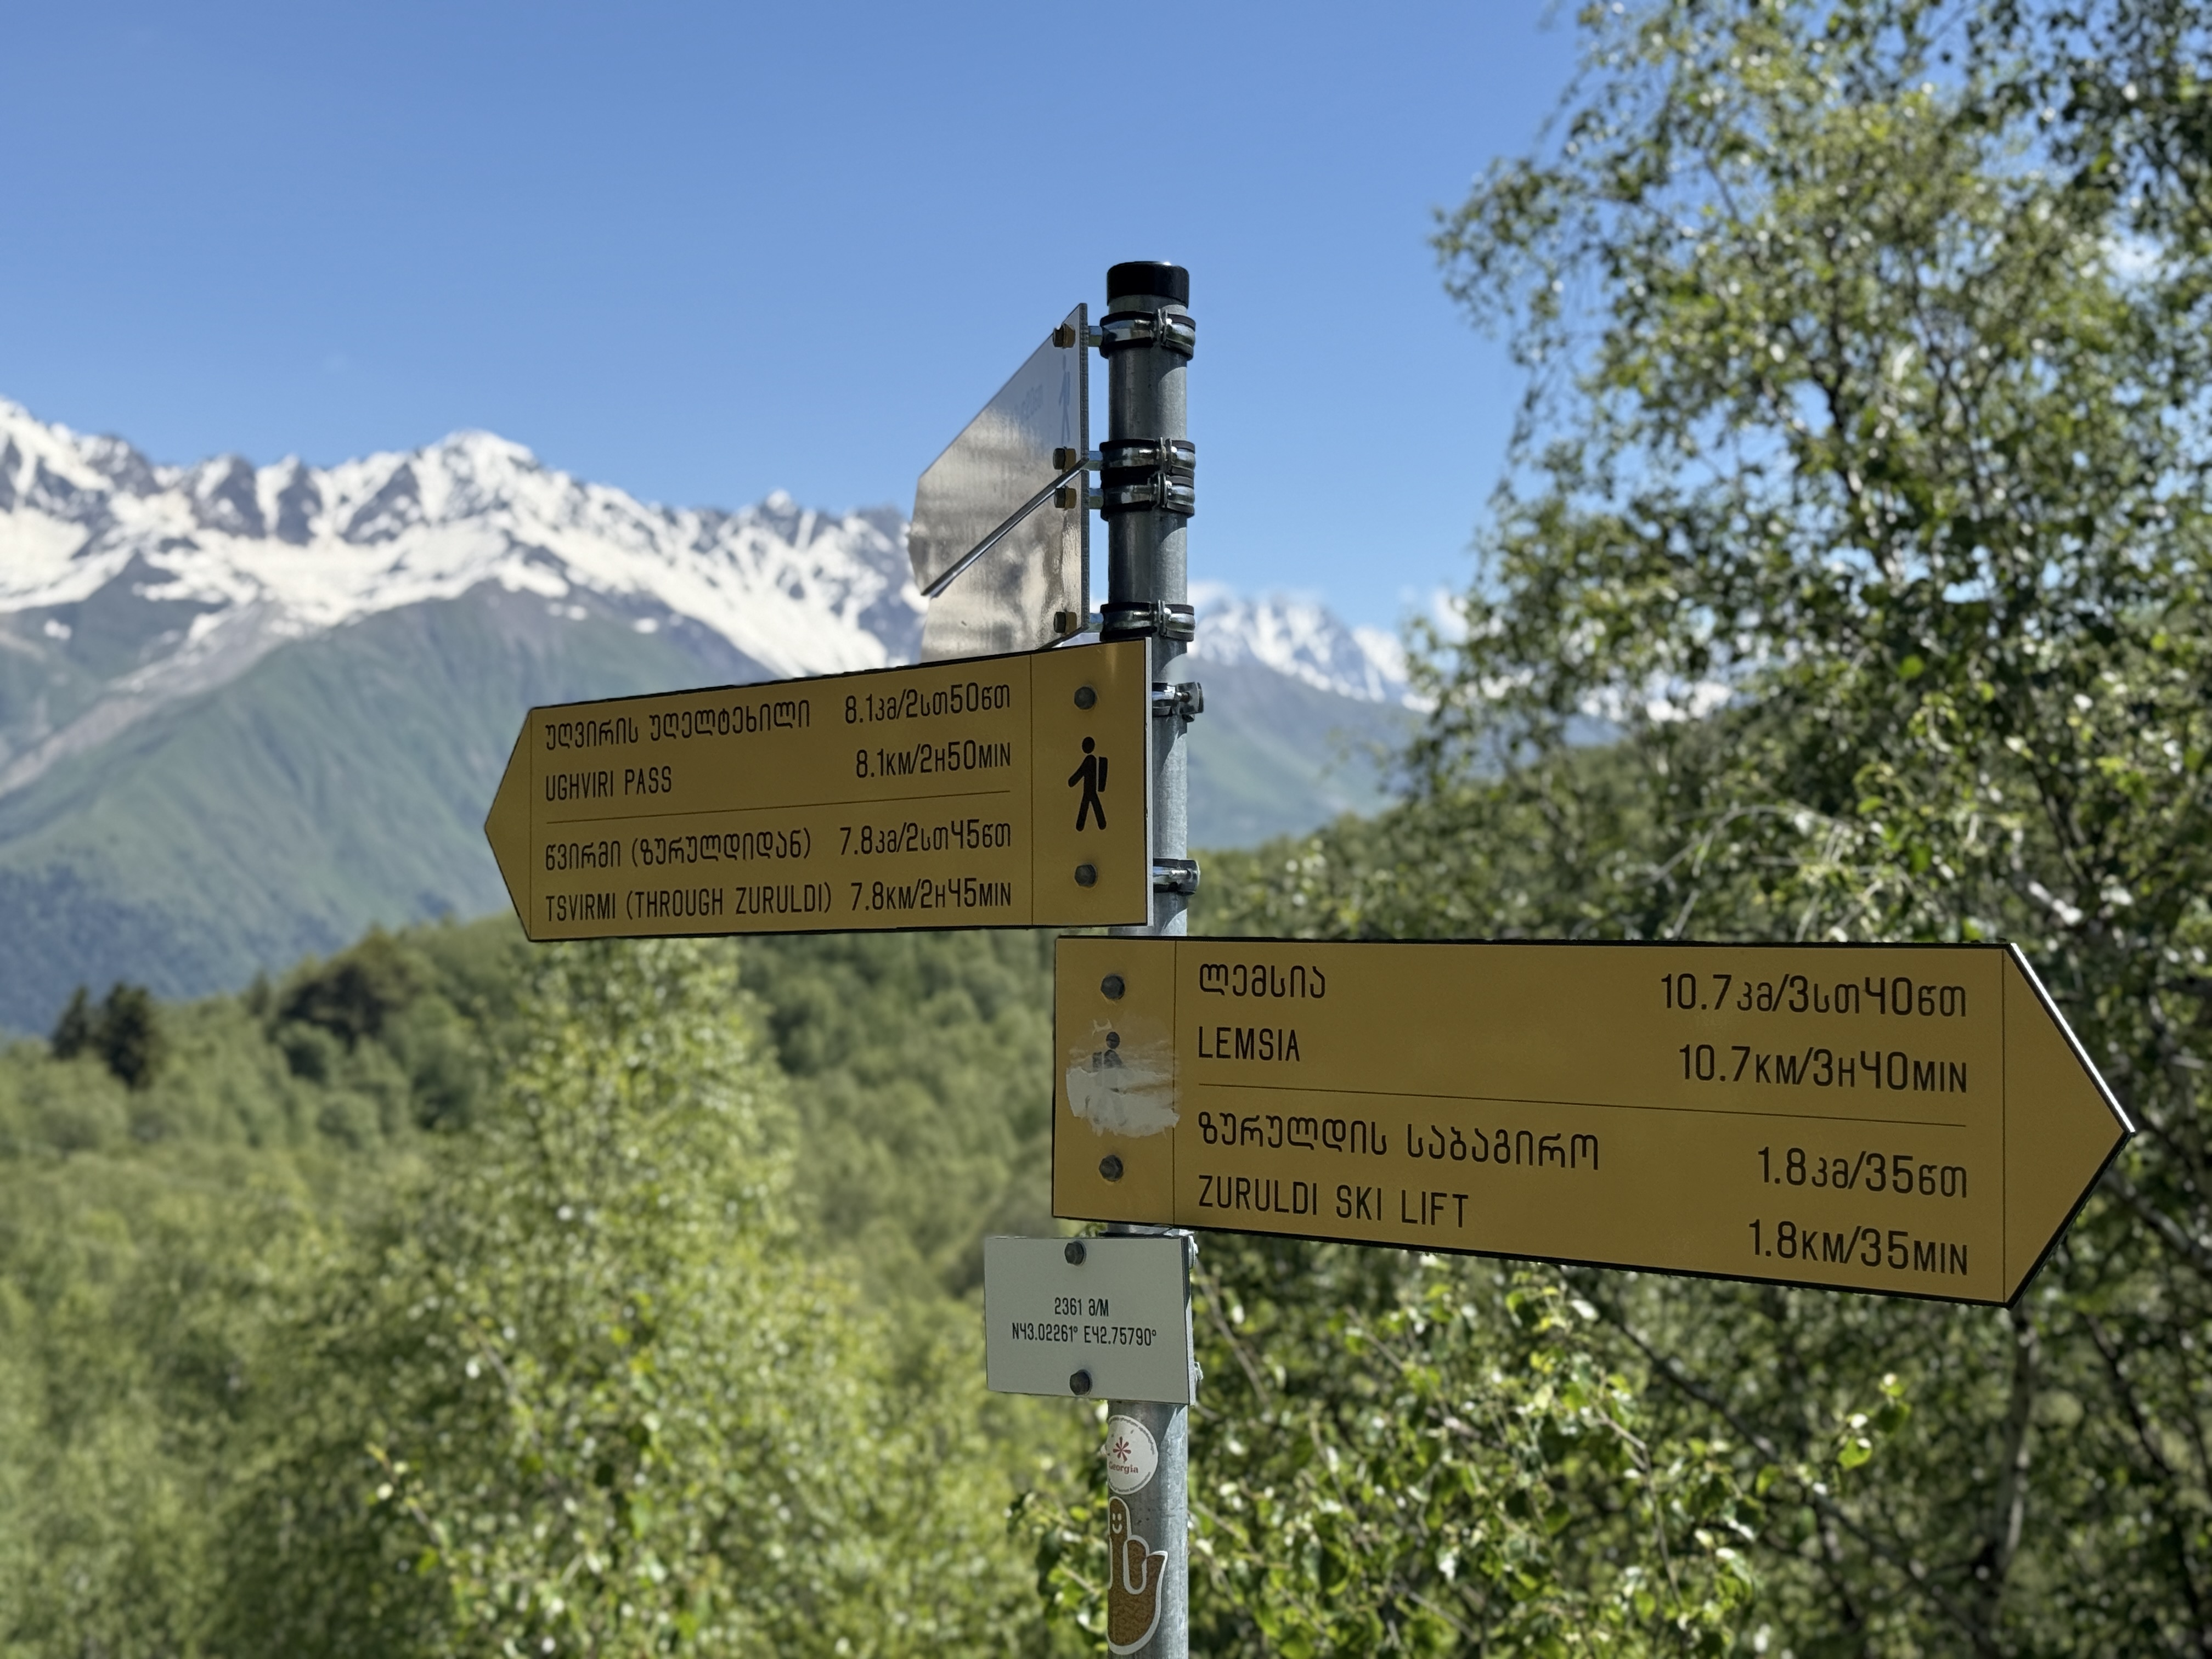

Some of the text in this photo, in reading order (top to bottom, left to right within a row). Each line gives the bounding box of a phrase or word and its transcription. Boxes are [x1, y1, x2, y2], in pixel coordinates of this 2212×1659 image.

[545, 717, 639, 751] უღვირის
[648, 699, 810, 741] უღელტეხილი
[546, 770, 613, 802] UGHVIRI
[625, 765, 672, 795] PASS
[545, 840, 620, 871] წვირმი
[631, 827, 811, 867] (ზურულდიდან)
[545, 893, 616, 922] TSVIRMI
[627, 888, 723, 920] (THROUGH
[736, 882, 831, 915] ZURULDI)
[1199, 963, 1325, 998] ლემსია
[1198, 1026, 1300, 1062] LEMSIA
[1198, 1111, 1387, 1155] ზურულდის
[1407, 1124, 1598, 1170] საბაგირო
[1198, 1175, 1317, 1216] ZURULDI
[1336, 1184, 1381, 1221] SKI
[1401, 1189, 1469, 1228] LIFT
[1054, 1297, 1082, 1316] 2361
[1108, 1461, 1139, 1475] Georgia
